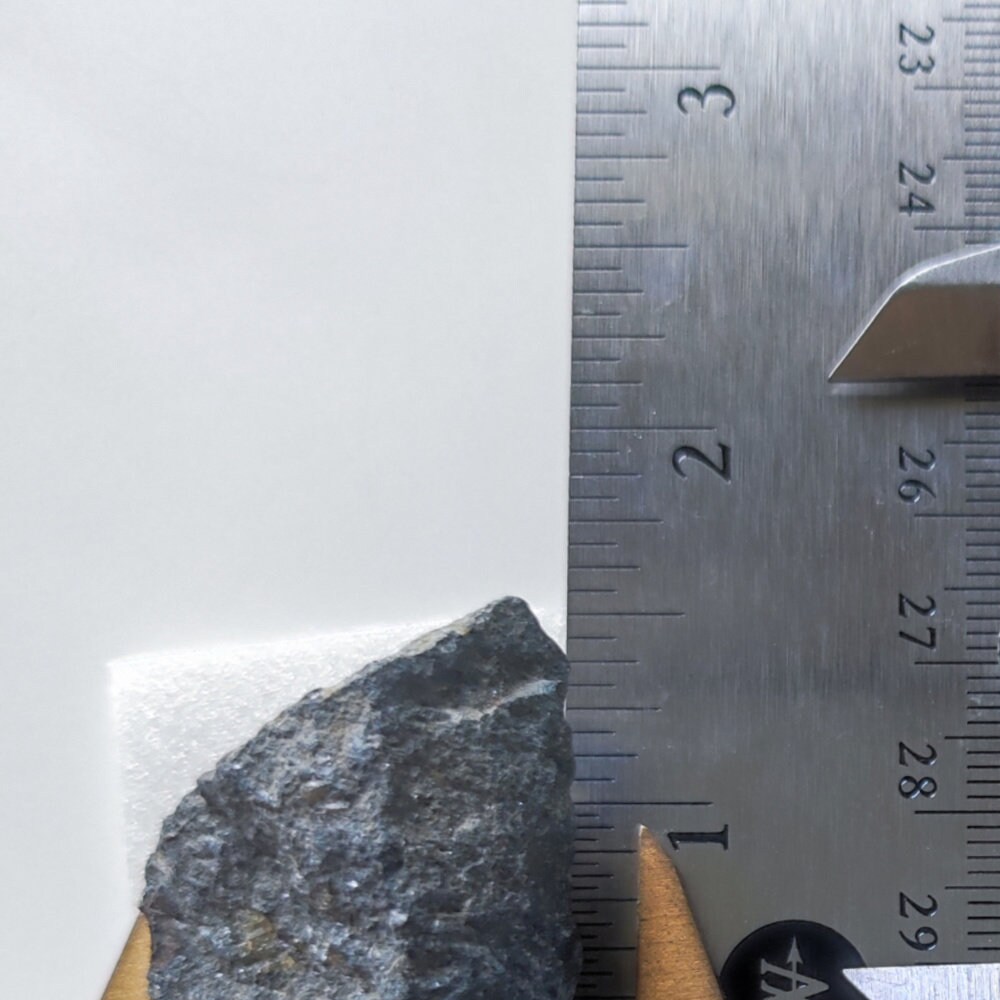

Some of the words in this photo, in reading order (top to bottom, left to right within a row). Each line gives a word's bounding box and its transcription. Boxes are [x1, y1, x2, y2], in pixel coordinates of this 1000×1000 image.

[898, 22, 936, 75] 23
[676, 84, 736, 118] 3
[898, 160, 936, 216] 24
[671, 442, 731, 484] 2
[898, 445, 936, 503] 26
[898, 592, 936, 650] 27
[898, 740, 938, 799] 28
[666, 824, 729, 851] 1
[899, 890, 939, 951] 29
